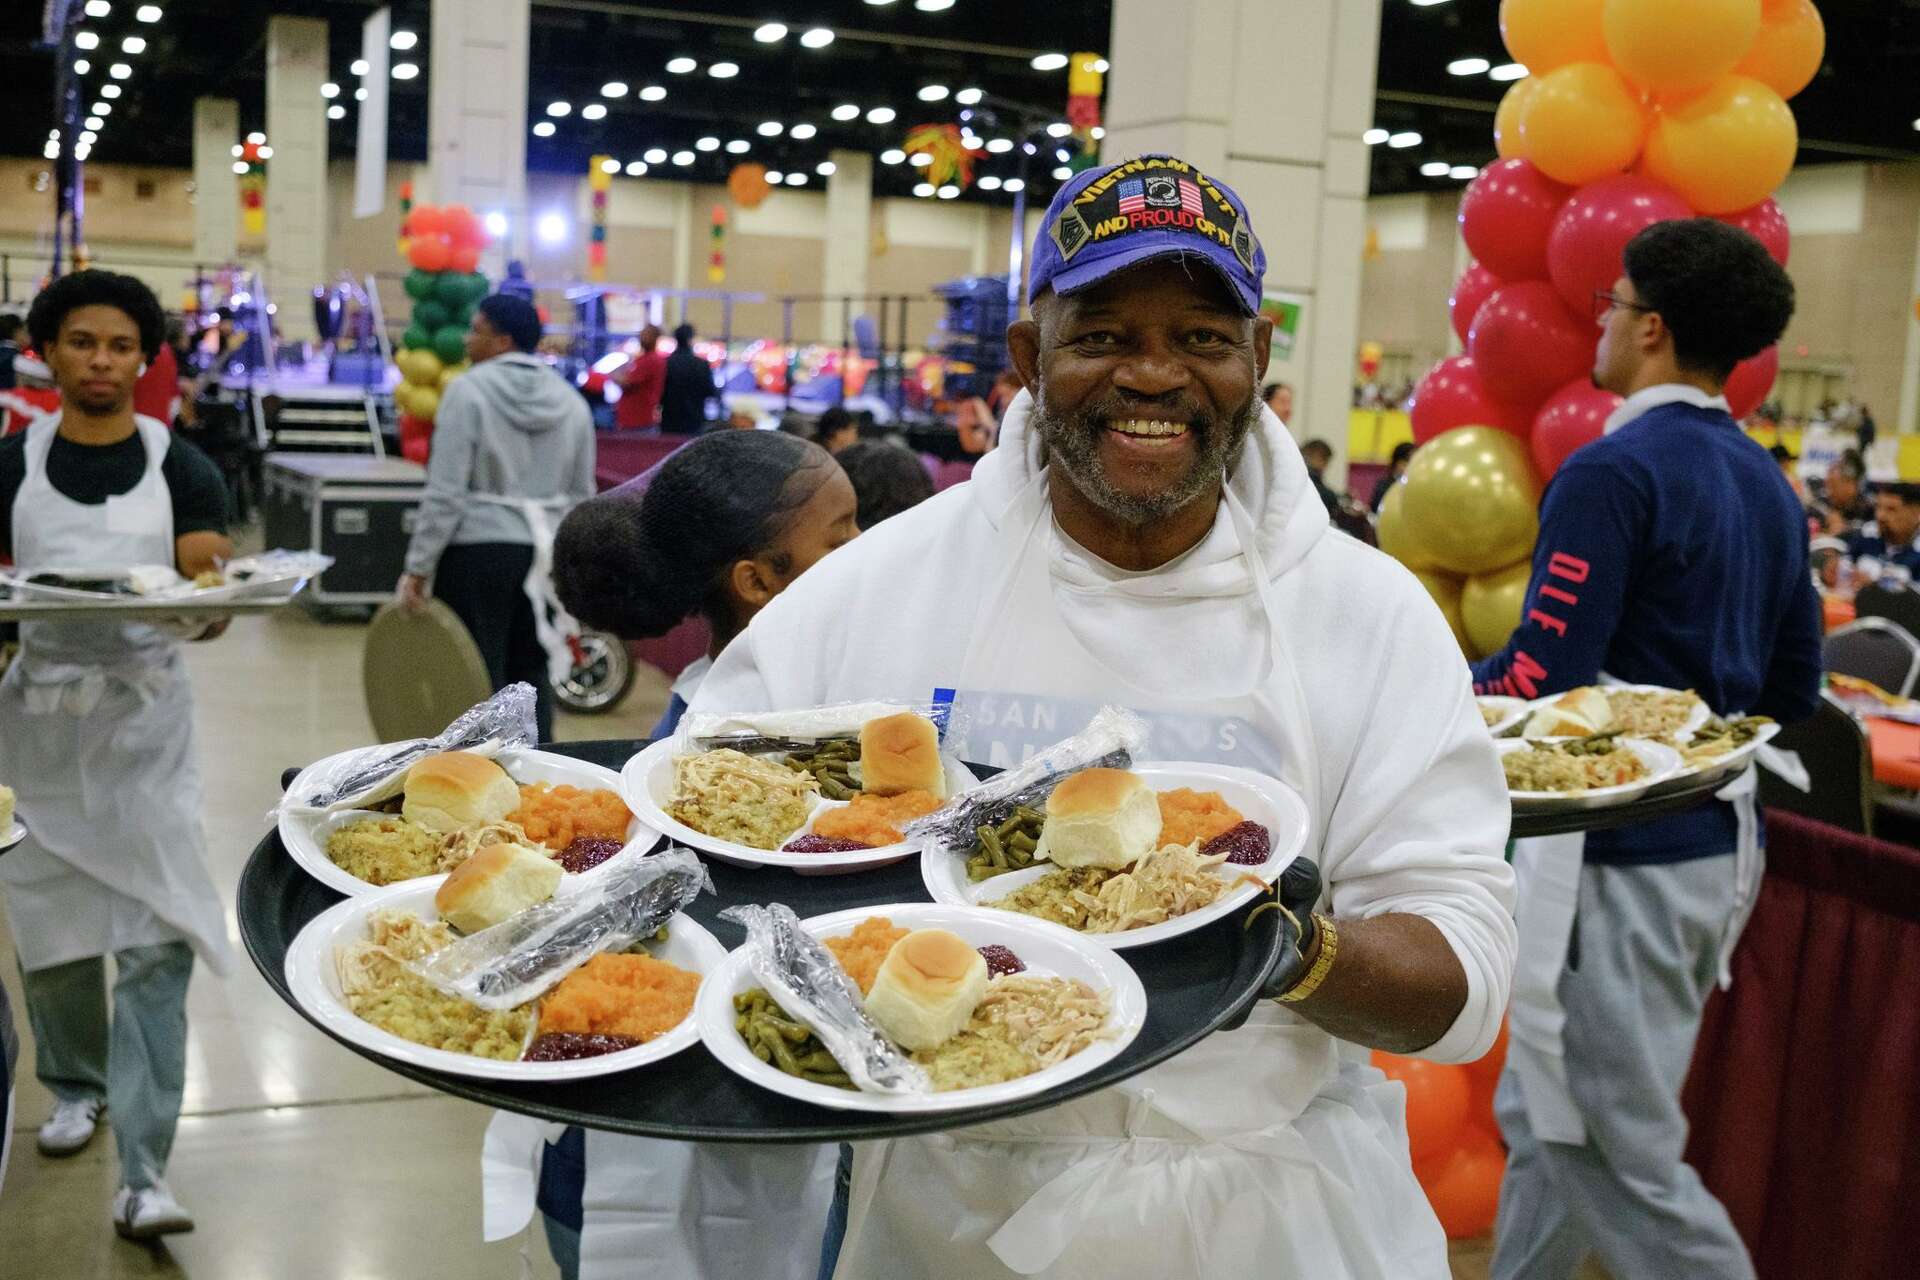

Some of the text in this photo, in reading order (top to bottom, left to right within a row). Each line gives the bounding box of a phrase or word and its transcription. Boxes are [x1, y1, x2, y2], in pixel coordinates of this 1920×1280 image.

[1073, 159, 1189, 206] VIETNAM
[1094, 208, 1231, 246] AND PROUD OF IT
[976, 696, 1057, 732] SAN
